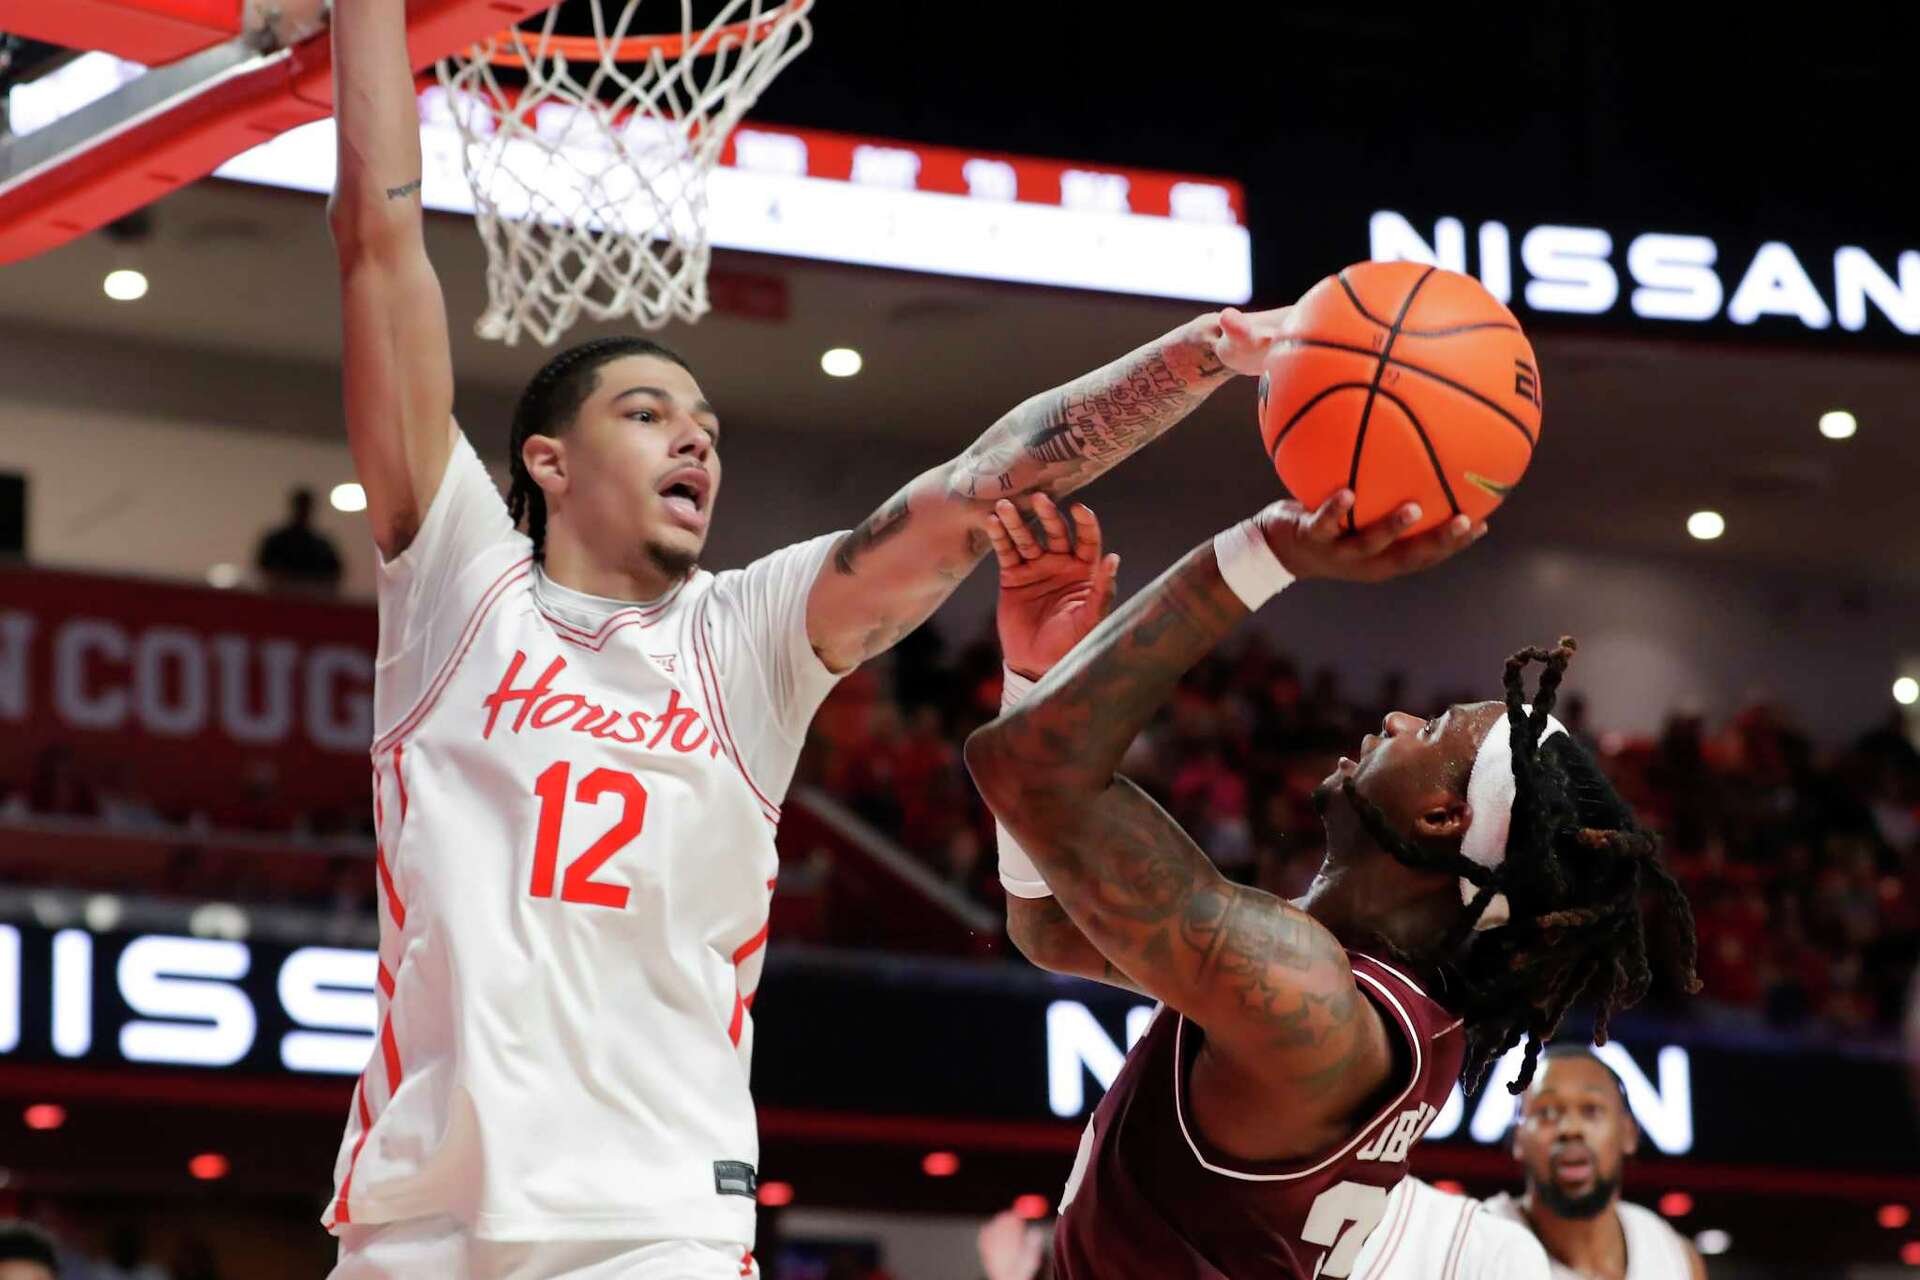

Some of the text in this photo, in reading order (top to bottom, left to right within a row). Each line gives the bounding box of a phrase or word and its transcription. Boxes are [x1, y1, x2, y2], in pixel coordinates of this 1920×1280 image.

[1369, 210, 1920, 334] NISSAN
[57, 617, 374, 752] COUG
[482, 649, 719, 760] Housto
[529, 760, 648, 909] 12
